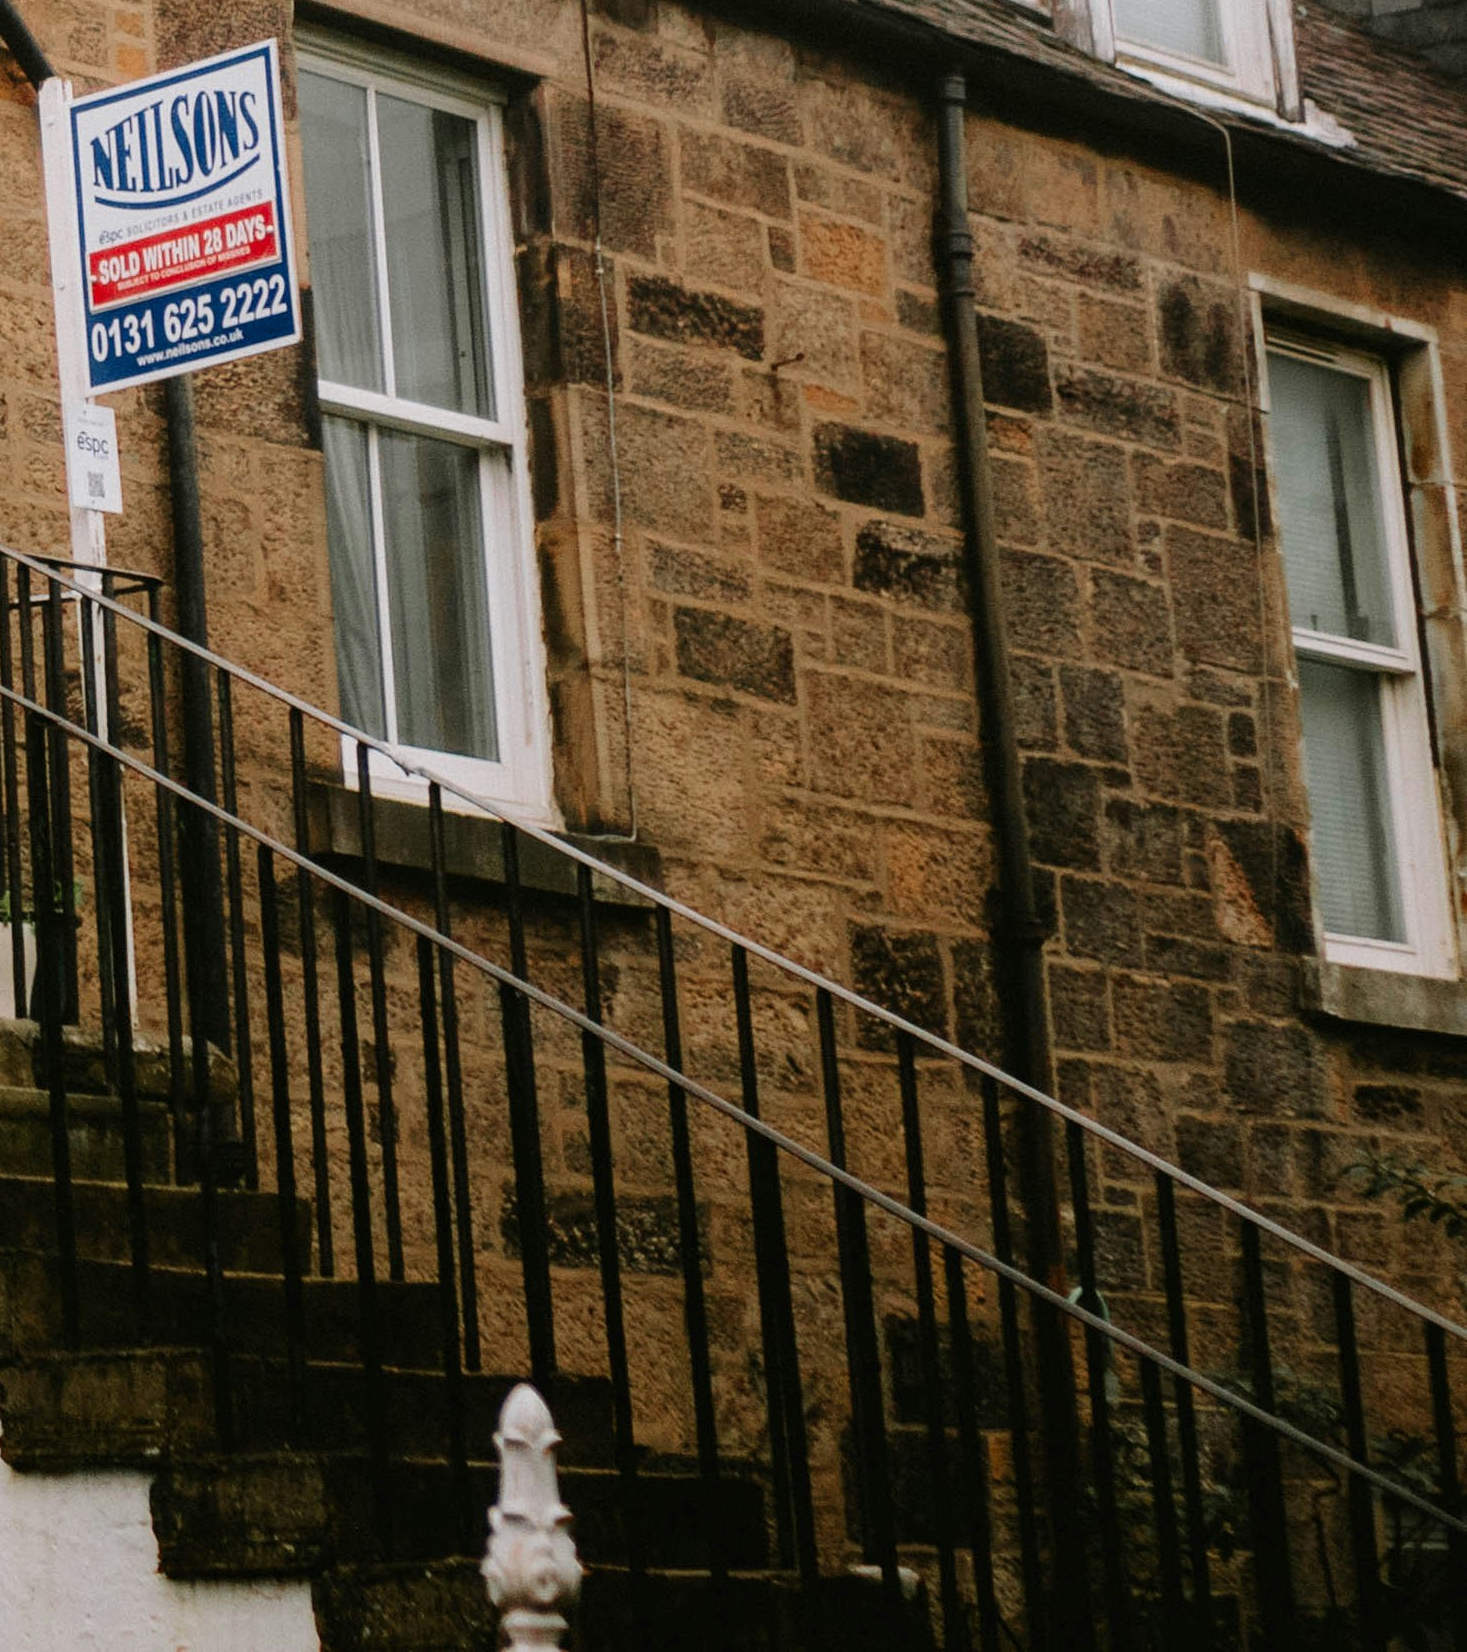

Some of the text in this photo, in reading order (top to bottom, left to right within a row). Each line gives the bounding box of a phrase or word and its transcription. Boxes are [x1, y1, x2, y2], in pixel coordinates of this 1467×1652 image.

[90, 91, 259, 192] NEILSONS
[126, 213, 179, 236] SOLICITORS
[192, 200, 224, 218] ESTATE
[227, 189, 263, 207] AGENTS
[98, 214, 266, 285] SOLD WITHIN 28 DAYS
[117, 275, 149, 291] SUBJECT
[150, 271, 160, 281] TO
[161, 260, 206, 278] CONCLUSION
[207, 255, 218, 265] OF
[91, 274, 288, 362] 0131 625 2222
[136, 328, 244, 367] www.neilsons.co.uk
